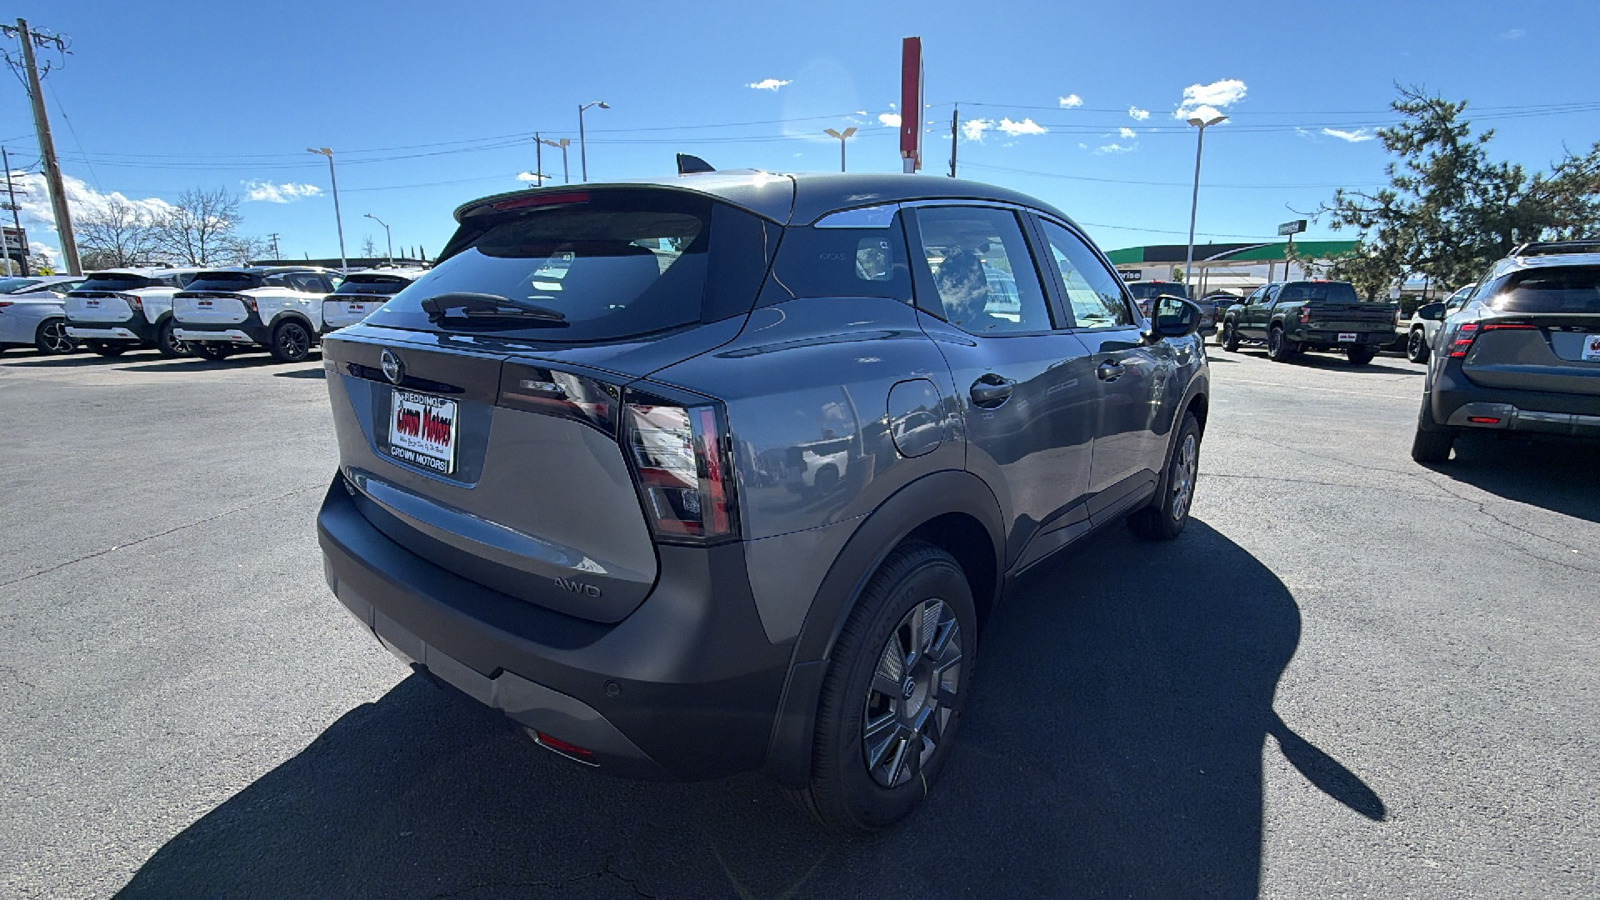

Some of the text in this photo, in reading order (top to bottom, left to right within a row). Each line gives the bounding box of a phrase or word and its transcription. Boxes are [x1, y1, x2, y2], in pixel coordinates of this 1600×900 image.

[405, 393, 437, 405] REDDING
[397, 404, 452, 447] Crown Motors
[391, 446, 446, 471] CROWN MOTORS
[554, 577, 602, 597] AWD
